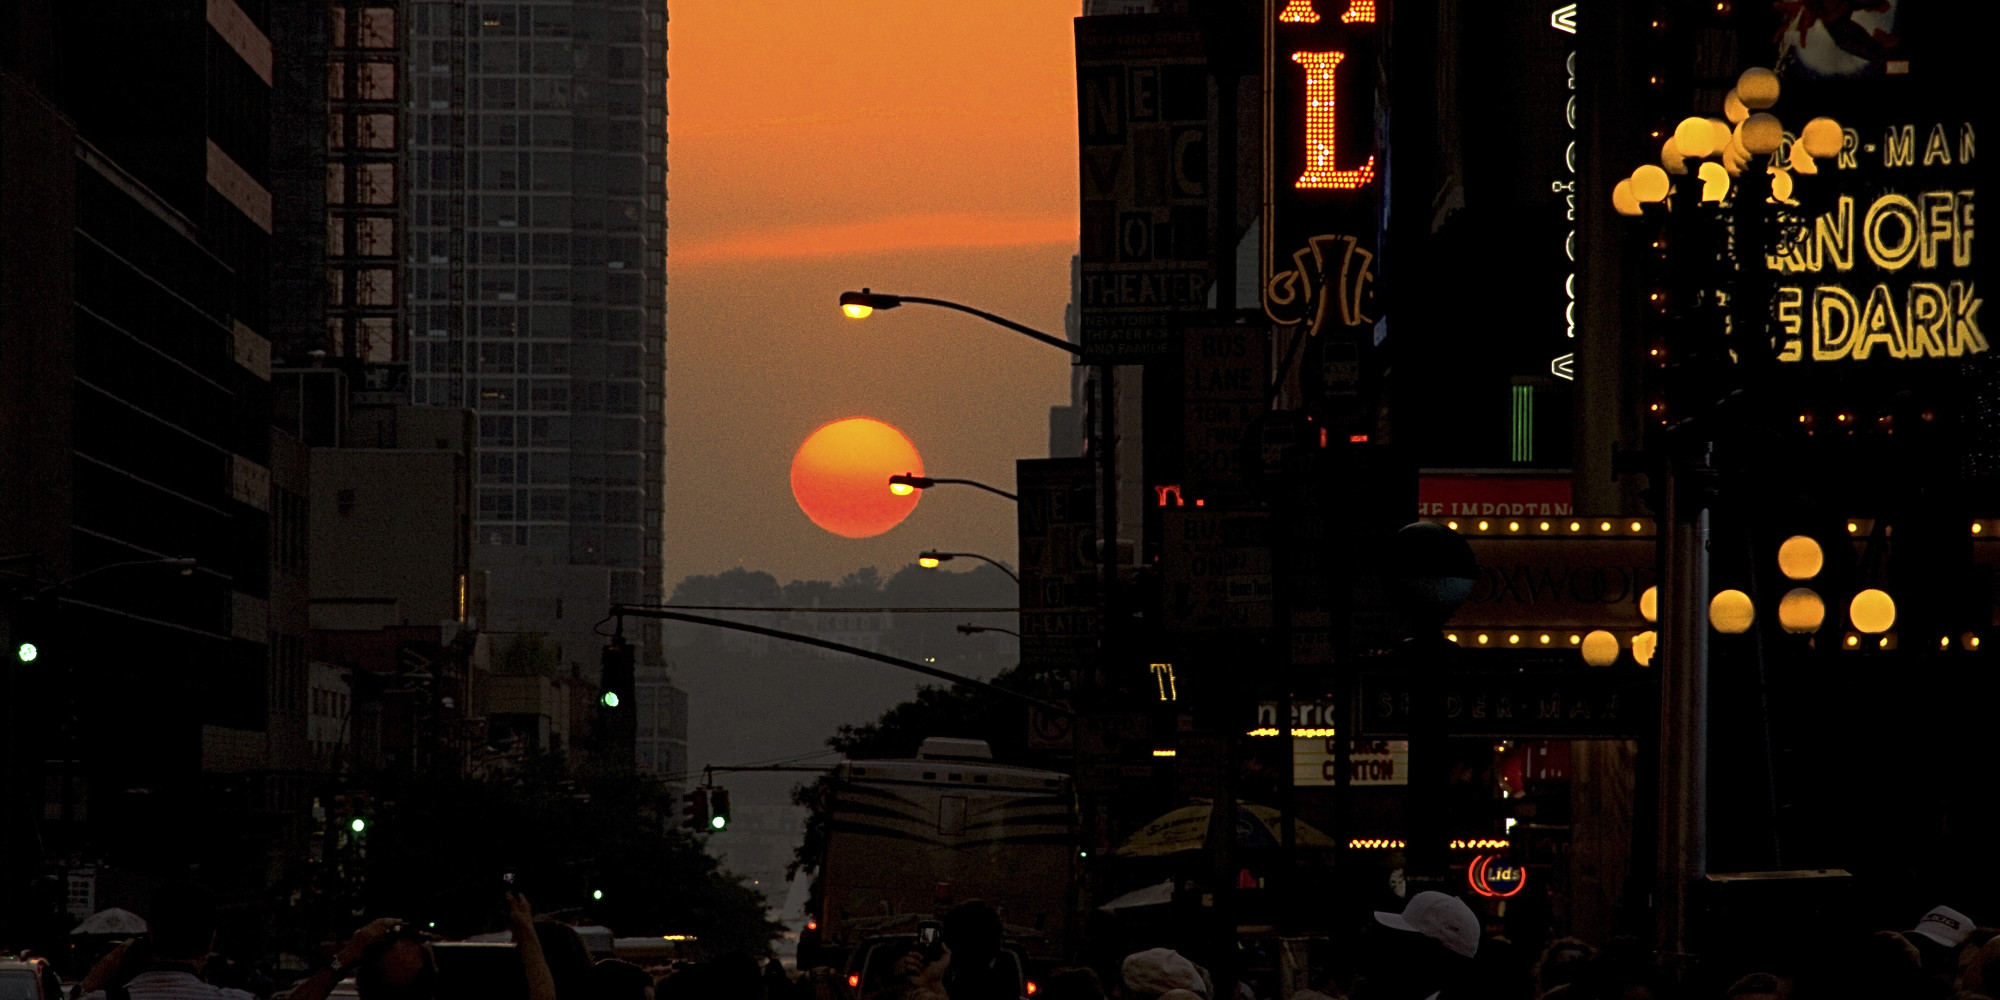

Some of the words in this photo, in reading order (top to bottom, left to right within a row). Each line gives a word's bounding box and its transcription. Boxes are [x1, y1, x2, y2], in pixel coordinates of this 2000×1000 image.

[1083, 272, 1206, 304] THEATER
[1812, 280, 1991, 362] DARK
[1202, 334, 1247, 358] BUS
[1195, 367, 1252, 391] LANE
[1450, 502, 1574, 516] IMPORTAN
[1184, 519, 1224, 541] BU
[1022, 614, 1097, 633] THEATER
[1322, 760, 1394, 781] CNTON
[1487, 866, 1521, 881] Lids
